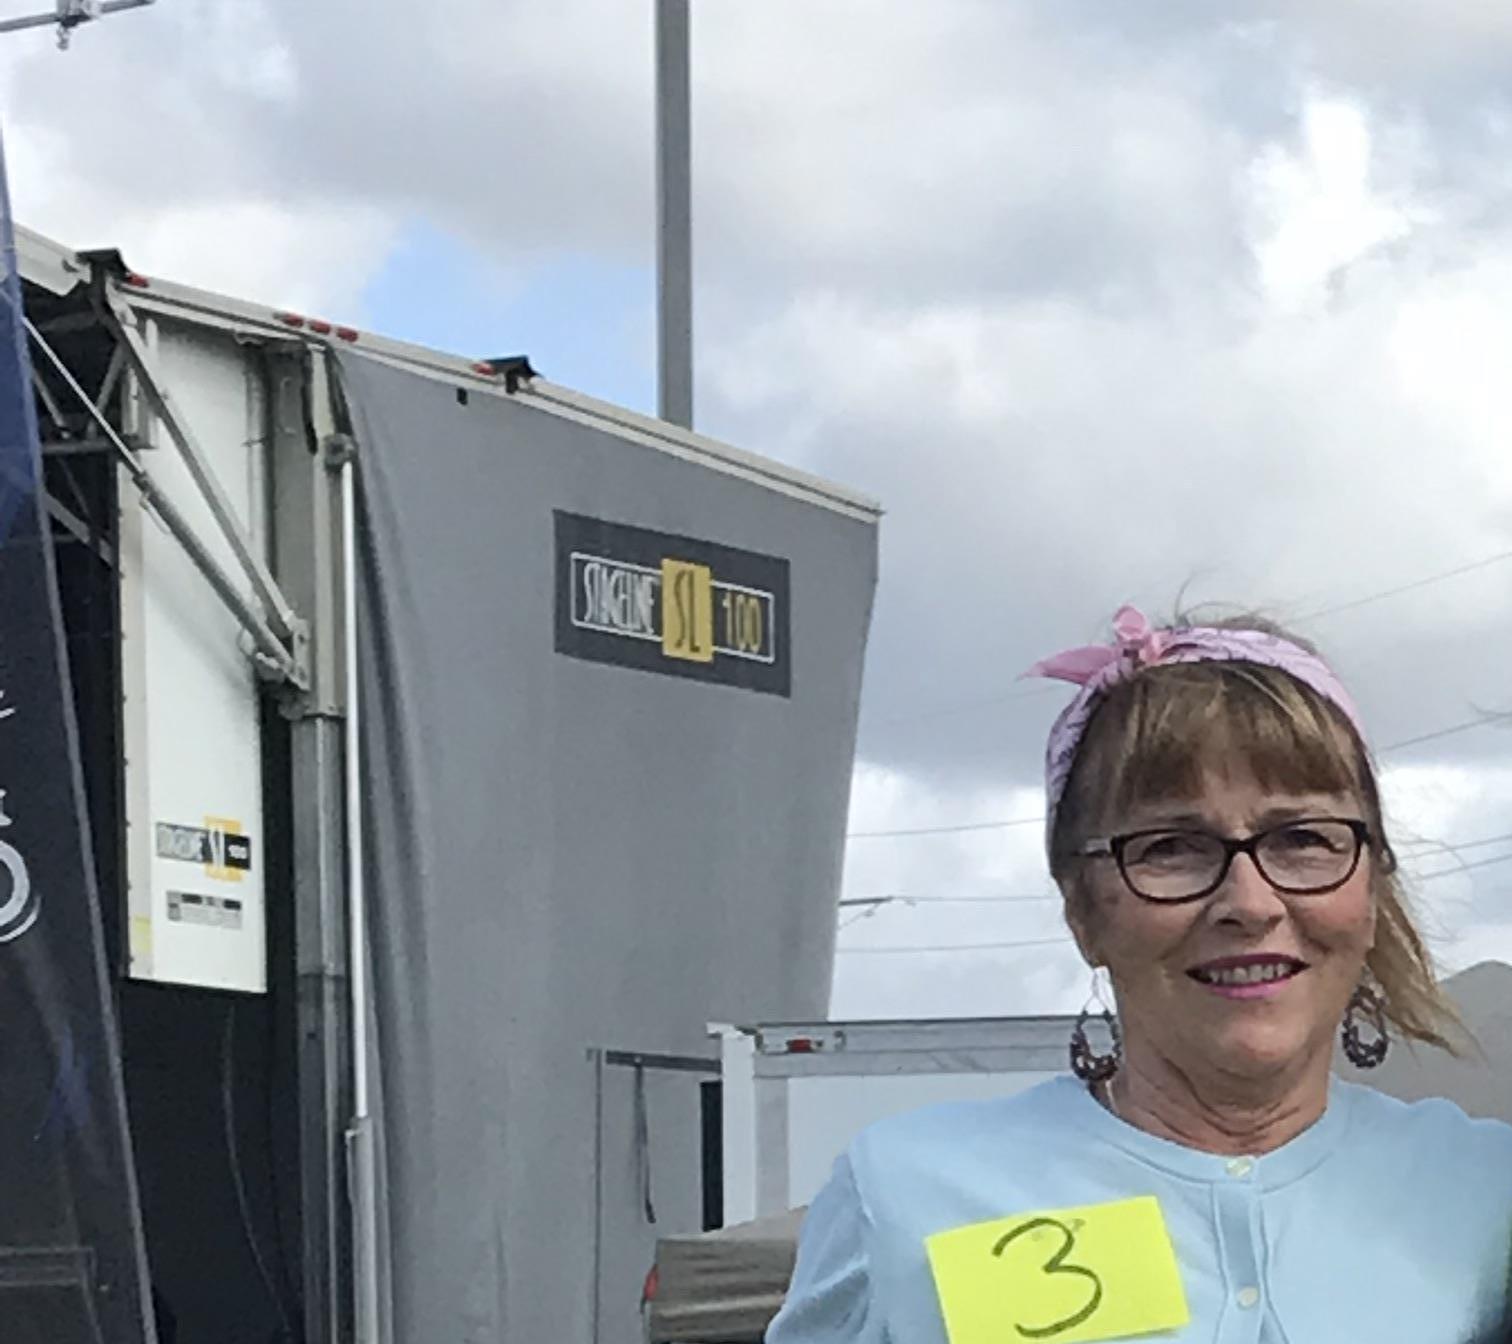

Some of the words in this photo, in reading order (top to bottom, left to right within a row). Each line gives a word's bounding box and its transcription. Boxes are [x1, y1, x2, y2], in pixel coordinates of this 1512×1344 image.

[673, 569, 700, 652] SL
[722, 591, 762, 652] 100
[992, 1217, 1102, 1338] 3
